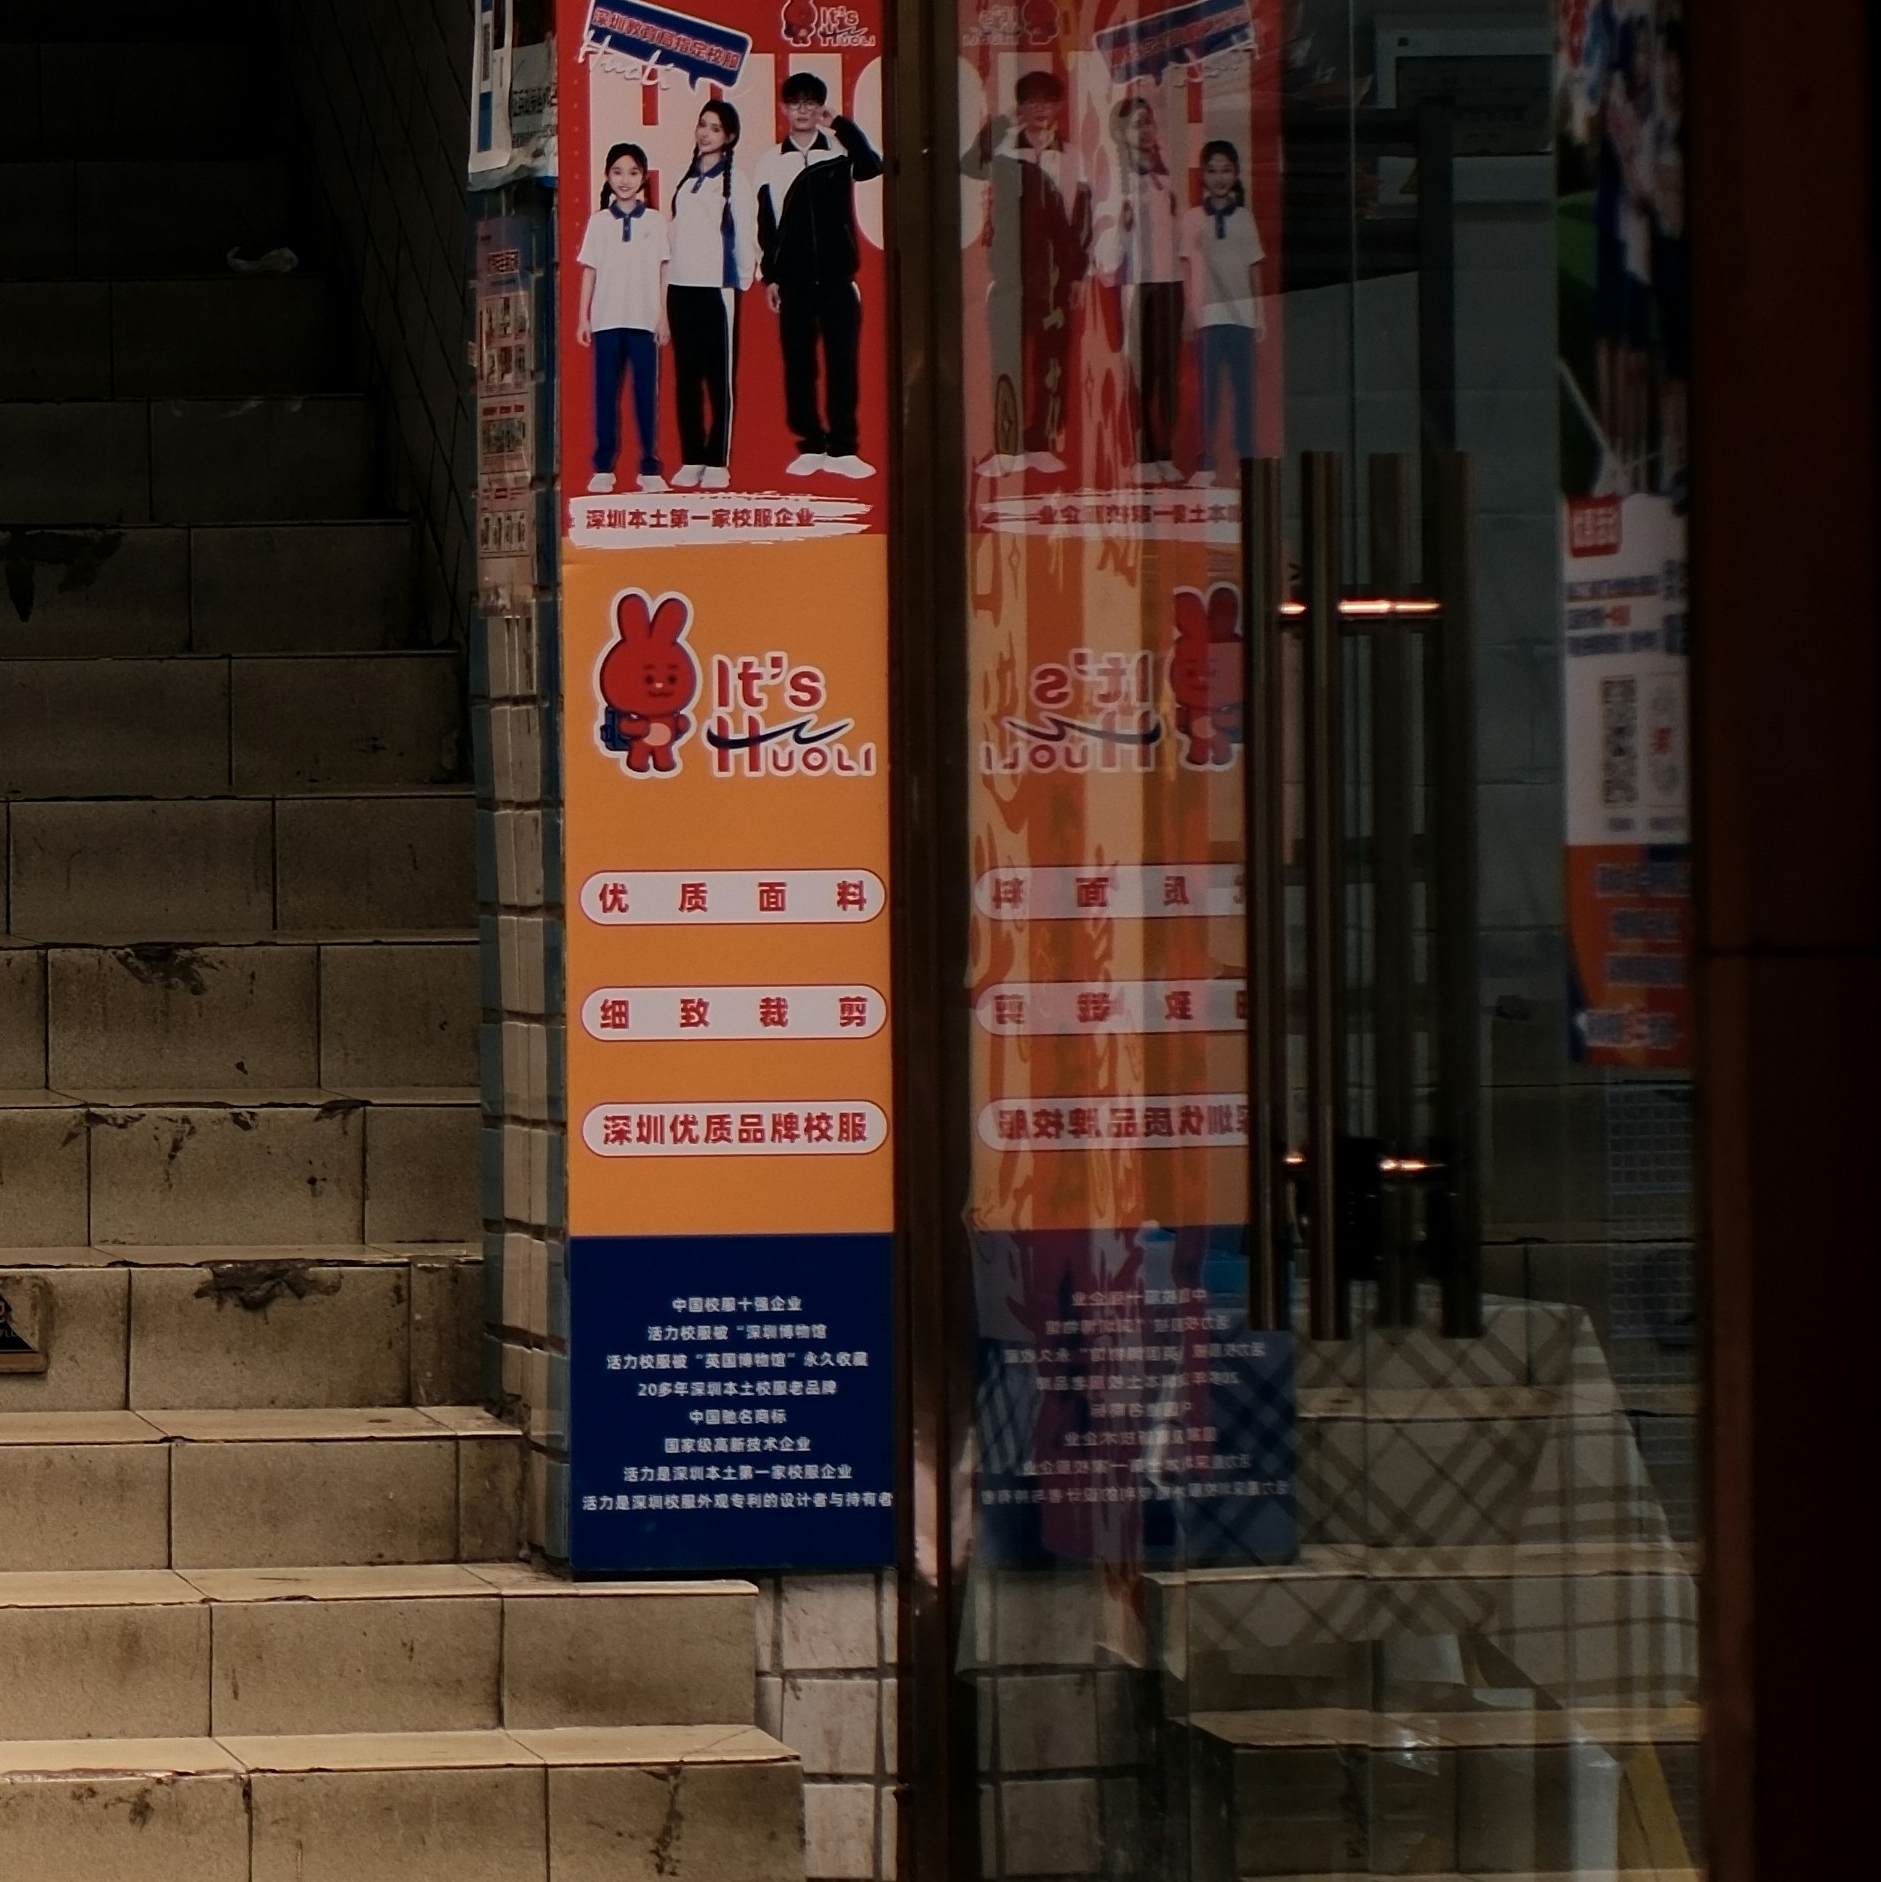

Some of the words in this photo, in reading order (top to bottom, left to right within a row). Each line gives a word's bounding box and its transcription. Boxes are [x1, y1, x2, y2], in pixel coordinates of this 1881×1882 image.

[586, 507, 816, 529] 深圳本土第一家校服企业
[716, 654, 823, 709] It's
[599, 880, 868, 914] 优质面料
[600, 996, 869, 1030] 细致裁剪
[603, 1111, 868, 1146] 深圳优质品牌校服
[672, 1295, 803, 1313] 中国校服十强企业
[637, 1379, 838, 1398] 20多年深圳本土校服老品牌
[689, 1408, 787, 1425] 中国驰名商标
[664, 1436, 811, 1454] 国家级高新技术企业
[623, 1464, 853, 1483] 活力是深圳本土第一家校服企业
